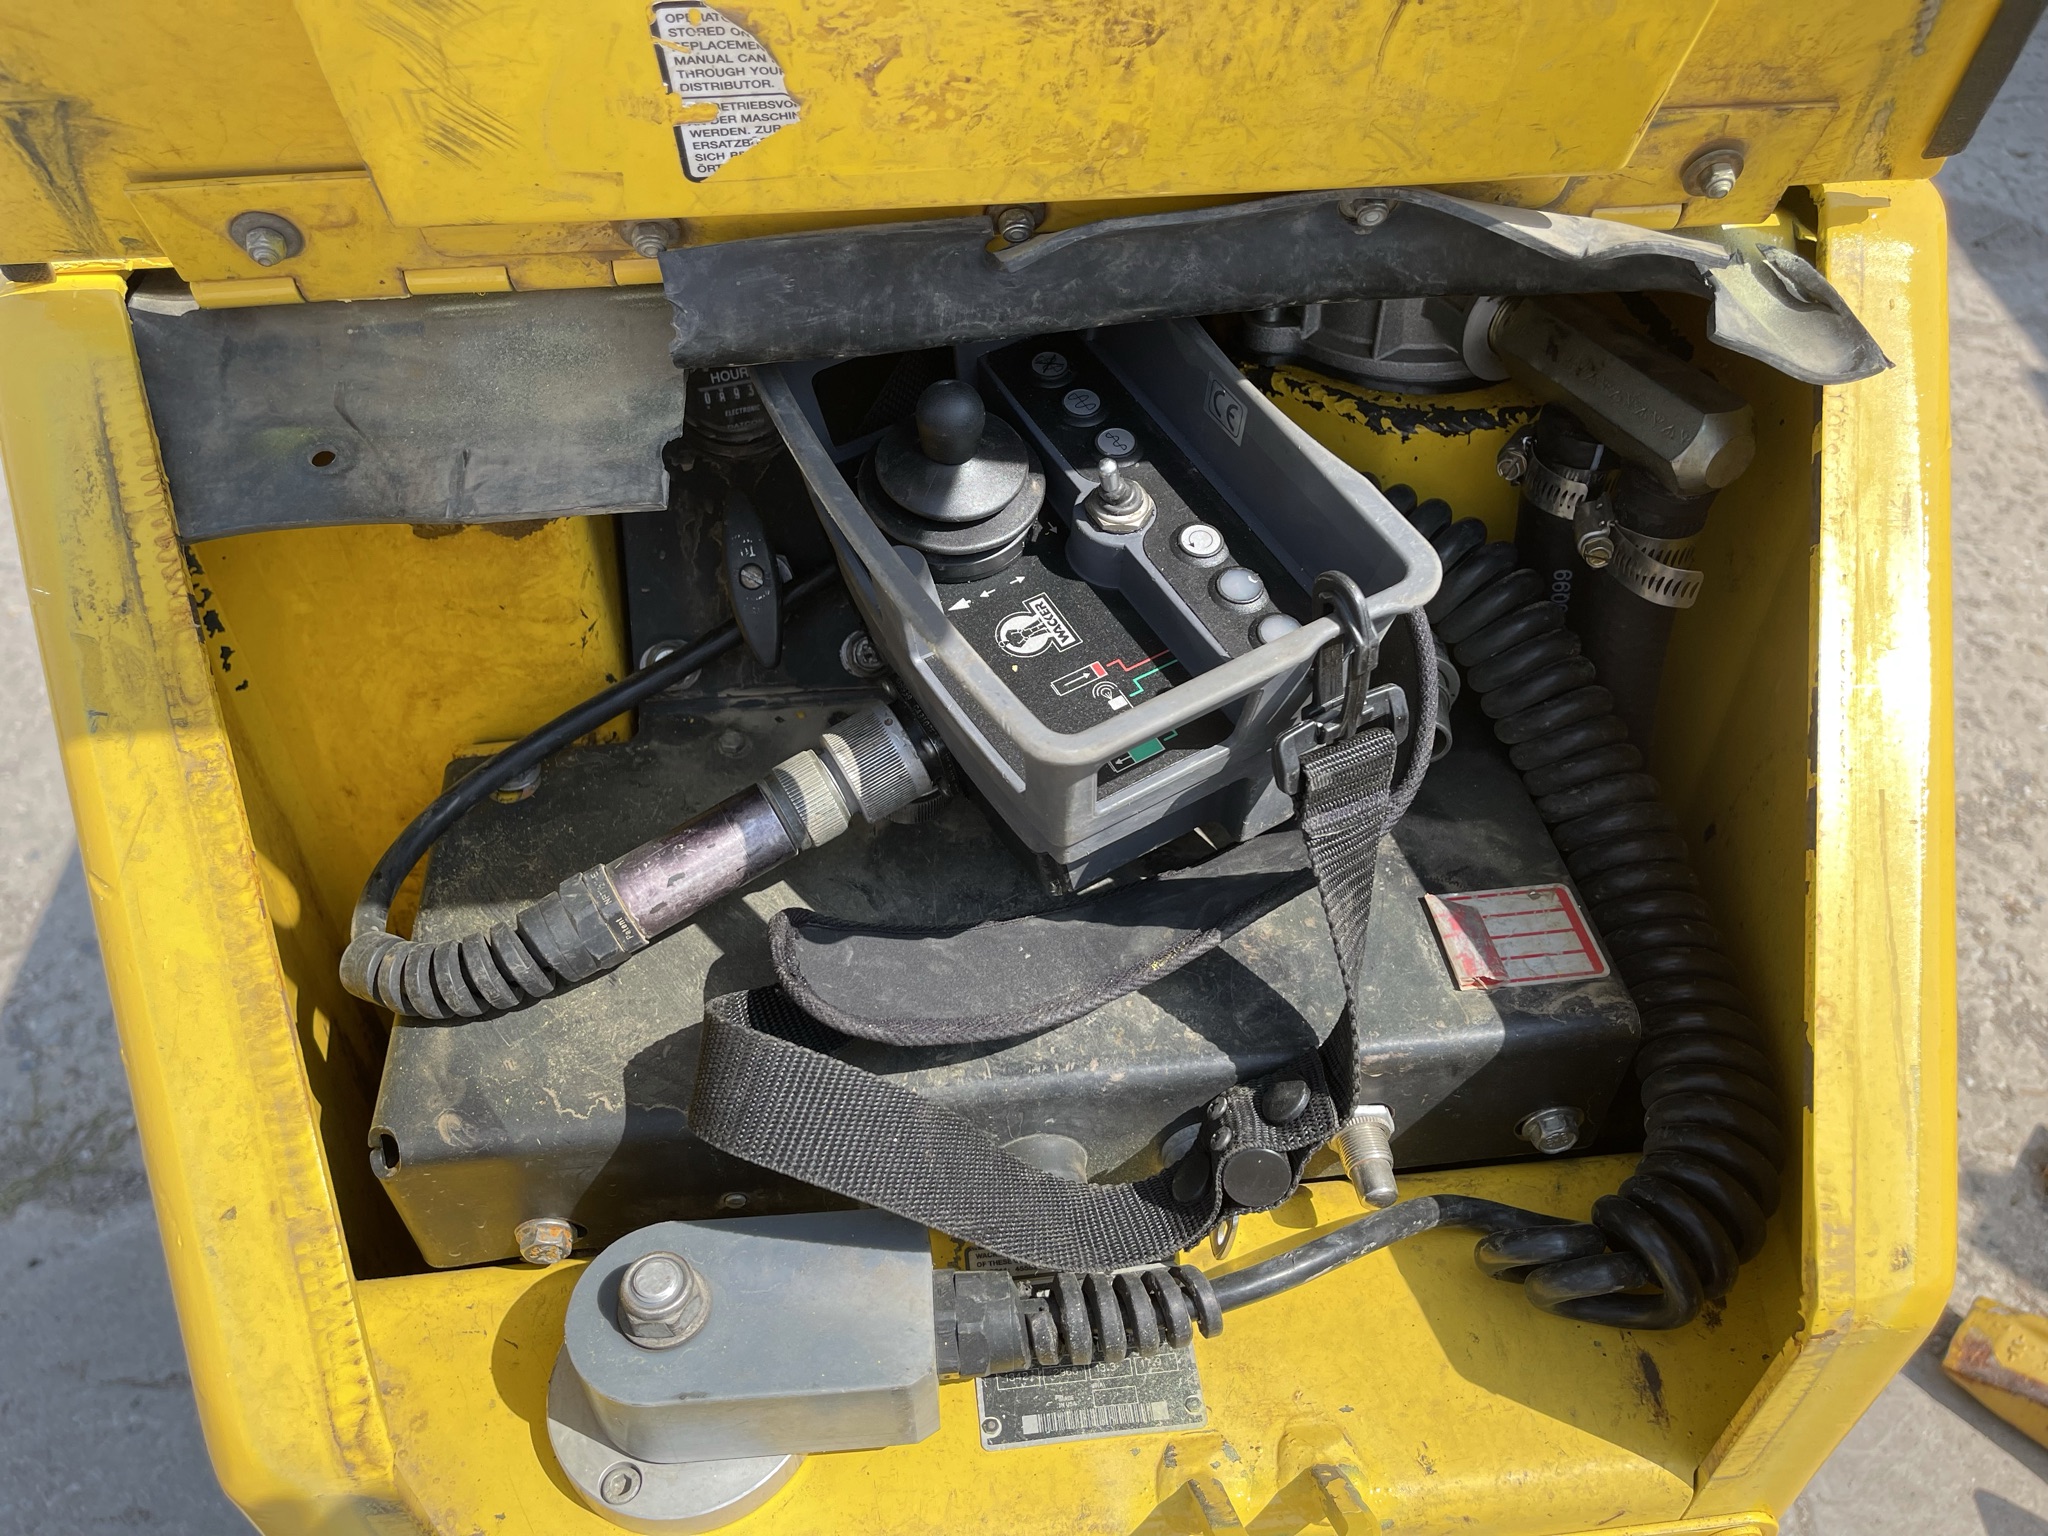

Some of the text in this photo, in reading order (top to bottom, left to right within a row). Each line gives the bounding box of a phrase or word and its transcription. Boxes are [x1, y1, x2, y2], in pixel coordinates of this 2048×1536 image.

[668, 26, 725, 37] STORED
[674, 54, 733, 65] MANUAL
[737, 54, 767, 63] CAN
[676, 67, 745, 78] THROUGH
[680, 80, 774, 92] DISTRIBUTOR.
[717, 100, 798, 112] ETRIEBSVO
[689, 126, 750, 138] WERDEN.
[695, 152, 725, 162] SICH
[710, 367, 749, 384] HOUR
[725, 404, 760, 417] ELECTRONIC
[1213, 390, 1239, 432] CE
[1034, 601, 1070, 644] WACKER
[615, 917, 634, 940] Patent
